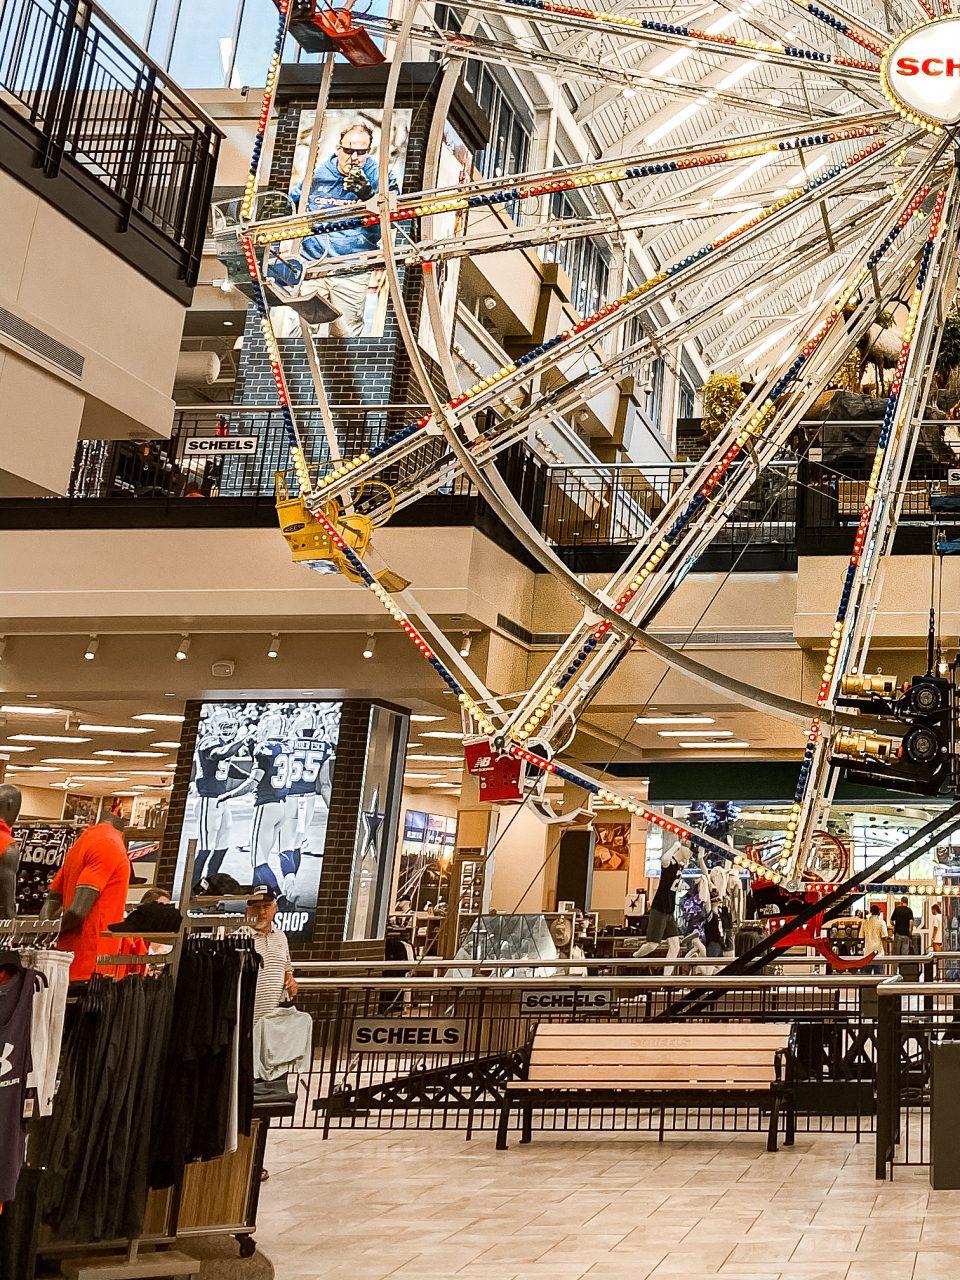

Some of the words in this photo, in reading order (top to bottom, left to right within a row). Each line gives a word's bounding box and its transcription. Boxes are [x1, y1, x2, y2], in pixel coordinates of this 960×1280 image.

[188, 440, 254, 450] SCHEELS
[274, 911, 309, 932] SHOP
[526, 994, 606, 1007] SCHEELS
[356, 1027, 459, 1044] SCHEELS
